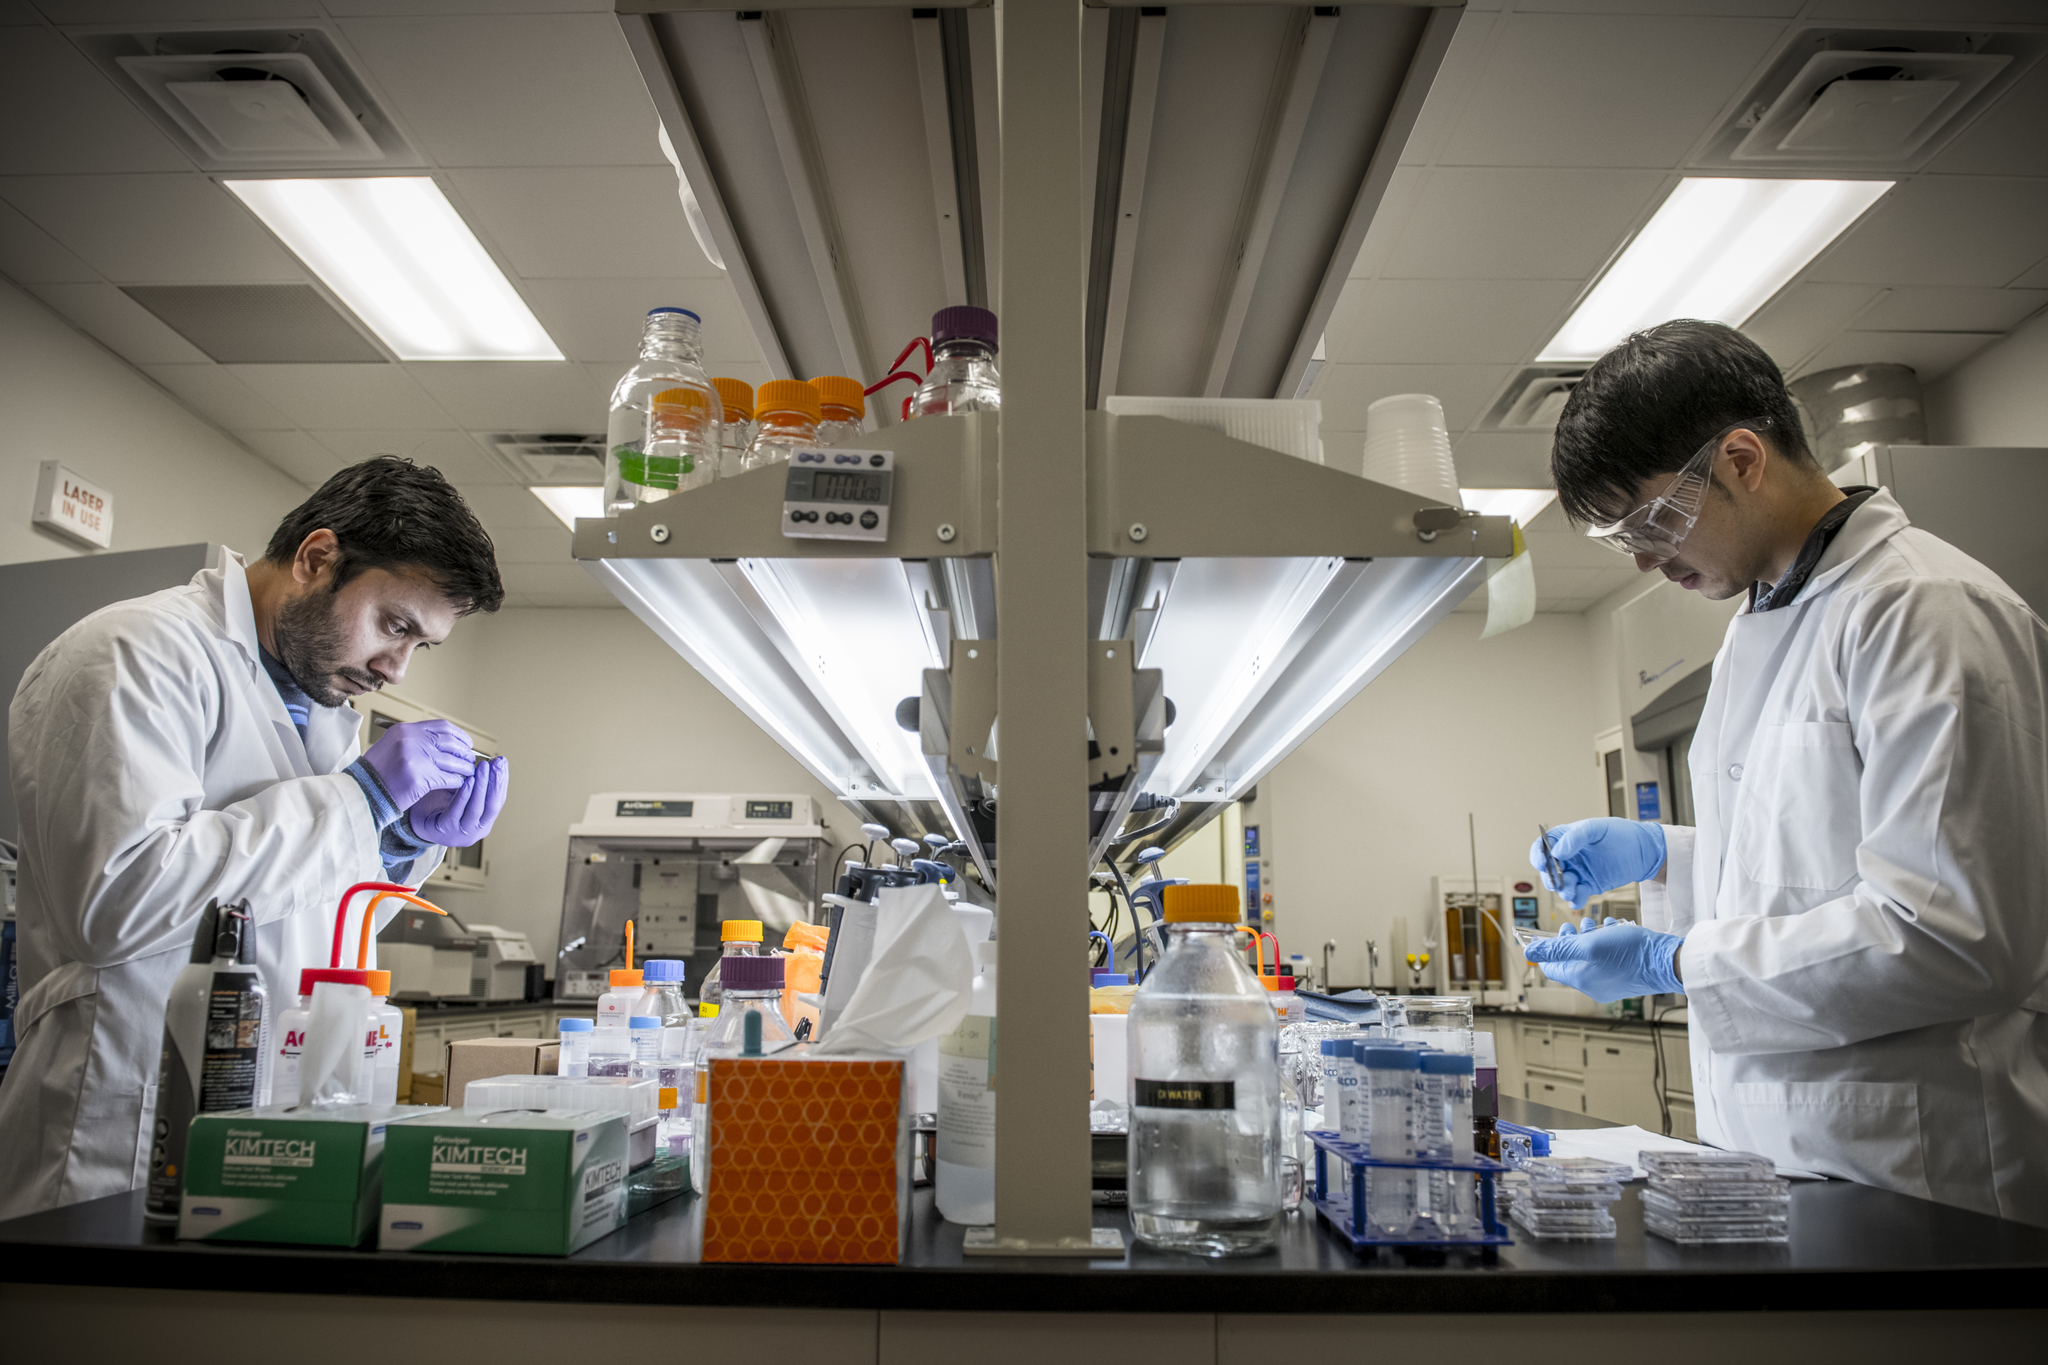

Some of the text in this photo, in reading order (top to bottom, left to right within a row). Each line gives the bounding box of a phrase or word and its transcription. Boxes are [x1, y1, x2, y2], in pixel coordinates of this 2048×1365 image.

[63, 480, 104, 514] LASER
[62, 500, 101, 531] IN USE
[1168, 1090, 1202, 1101] WATER
[225, 1139, 315, 1158] KIMTECH
[431, 1146, 527, 1165] KIMTECH
[584, 1161, 621, 1191] KIMTECH
